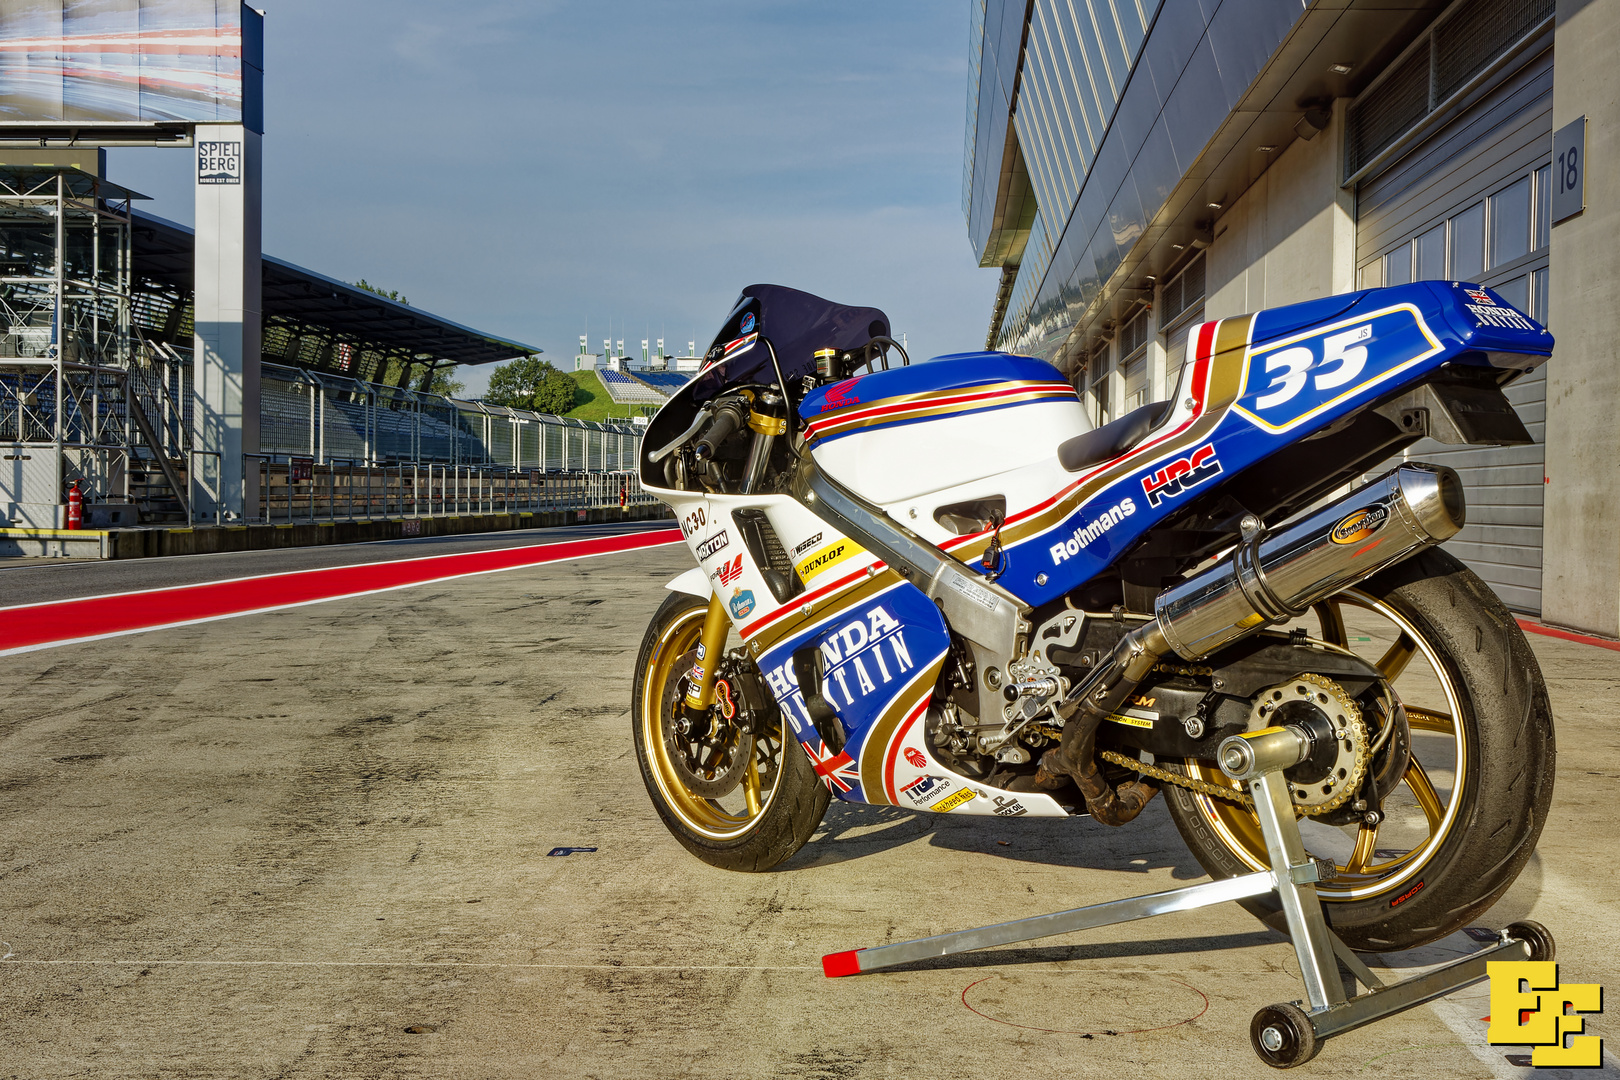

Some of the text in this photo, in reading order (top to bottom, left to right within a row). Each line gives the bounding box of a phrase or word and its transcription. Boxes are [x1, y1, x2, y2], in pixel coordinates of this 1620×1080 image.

[199, 143, 239, 156] SPIEL
[199, 158, 235, 170] BERG
[1558, 146, 1578, 195] 18
[1464, 303, 1523, 319] HONDA
[1358, 328, 1368, 339] JS
[1256, 323, 1373, 411] 35
[820, 396, 861, 413] HONDA
[1141, 442, 1224, 509] HRC
[795, 531, 823, 555] WISECO
[1049, 497, 1136, 565] Rothmans
[804, 545, 845, 575] DUNLOP
[1131, 719, 1152, 727] SYSTEM
[913, 780, 951, 806] Performance
[1012, 803, 1024, 812] OIL
[1189, 815, 1235, 871] ROSSO
[1391, 881, 1425, 907] CORSA
